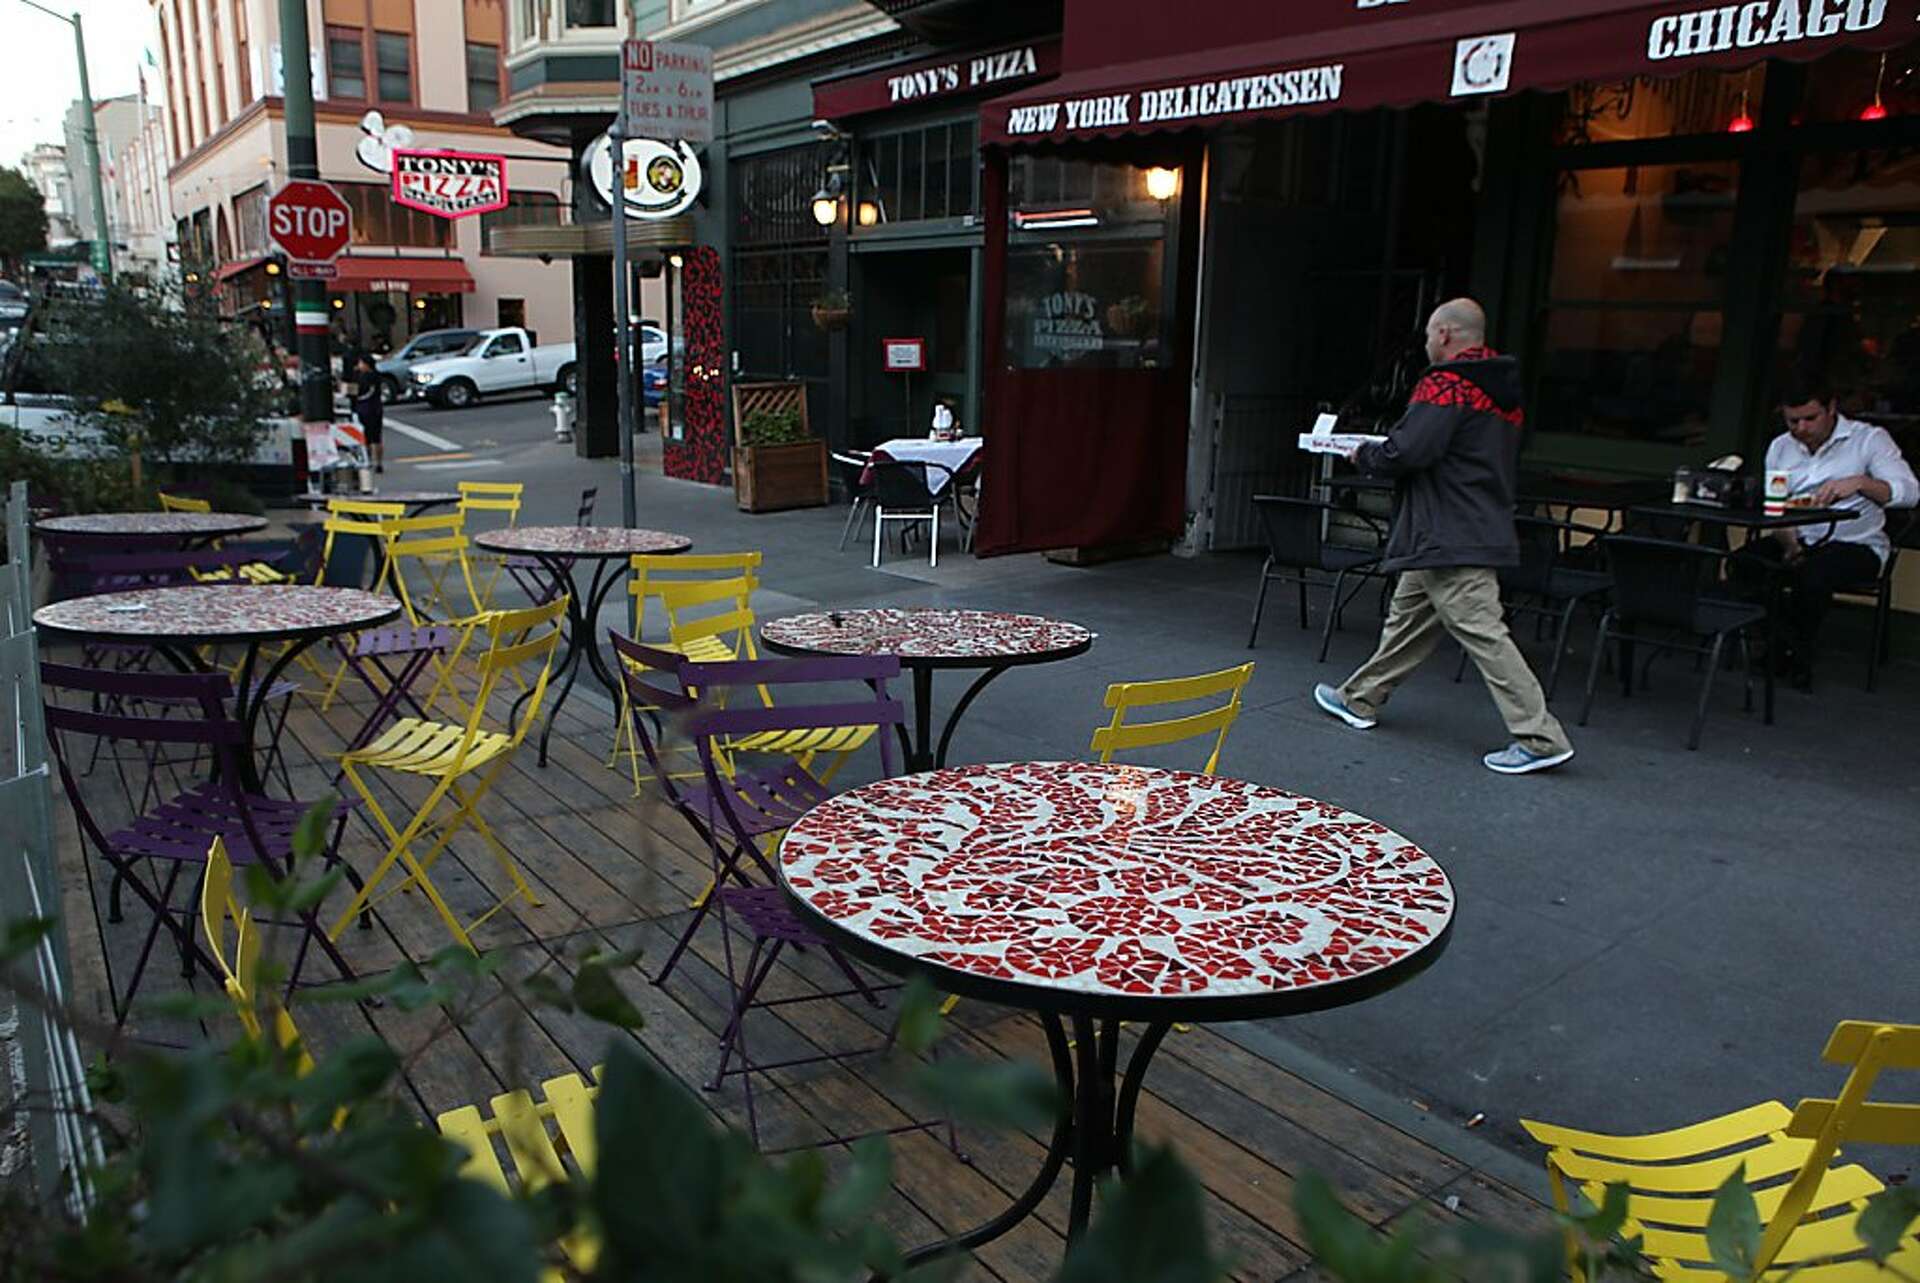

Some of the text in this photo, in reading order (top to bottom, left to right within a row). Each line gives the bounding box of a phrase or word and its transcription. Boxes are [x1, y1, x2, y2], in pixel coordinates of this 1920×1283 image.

[1648, 0, 1888, 60] CHICAGO
[627, 43, 650, 69] NO
[888, 47, 1037, 102] TONY'S PIZZA
[1007, 65, 1344, 134] NEW YORK DELICATESSEN
[398, 156, 500, 177] TONY'S
[402, 174, 497, 198] PIZZA
[273, 203, 345, 238] STOP
[1042, 291, 1097, 319] TONY'S
[1034, 318, 1104, 336] PIZZA
